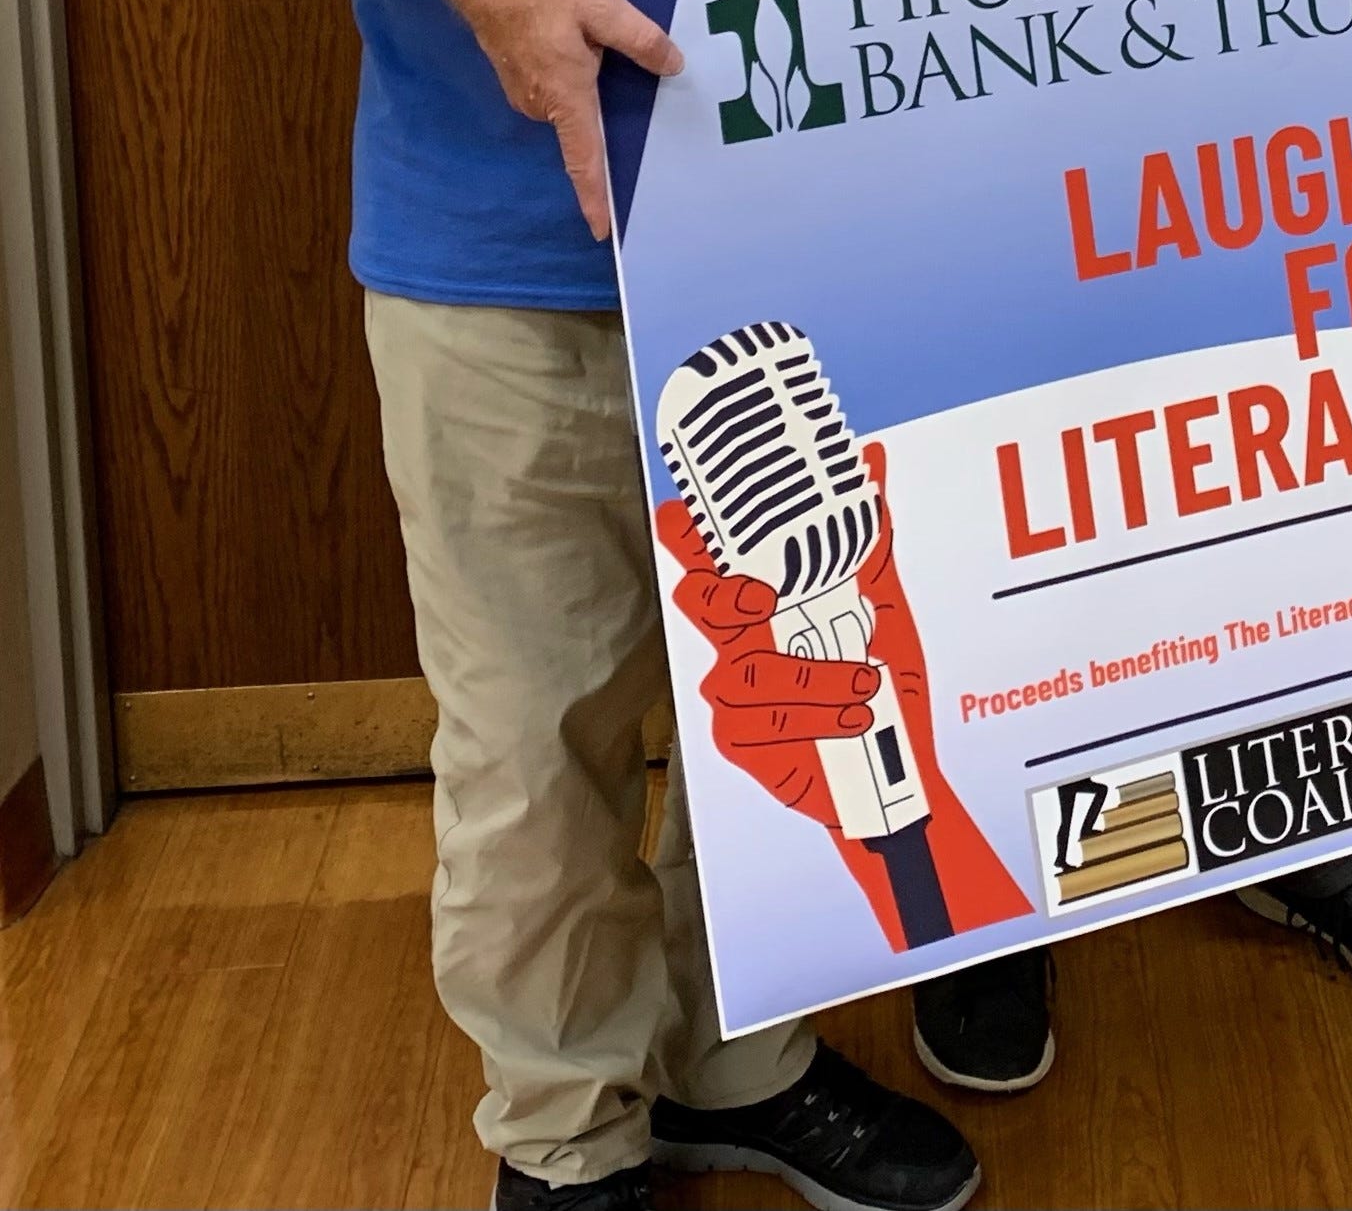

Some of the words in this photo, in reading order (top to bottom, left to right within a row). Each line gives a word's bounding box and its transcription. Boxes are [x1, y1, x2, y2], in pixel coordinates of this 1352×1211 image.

[850, 4, 1111, 120] BANK
[960, 668, 1084, 724] Proceeds
[1089, 635, 1219, 689] benefiting
[1223, 620, 1271, 651] The
